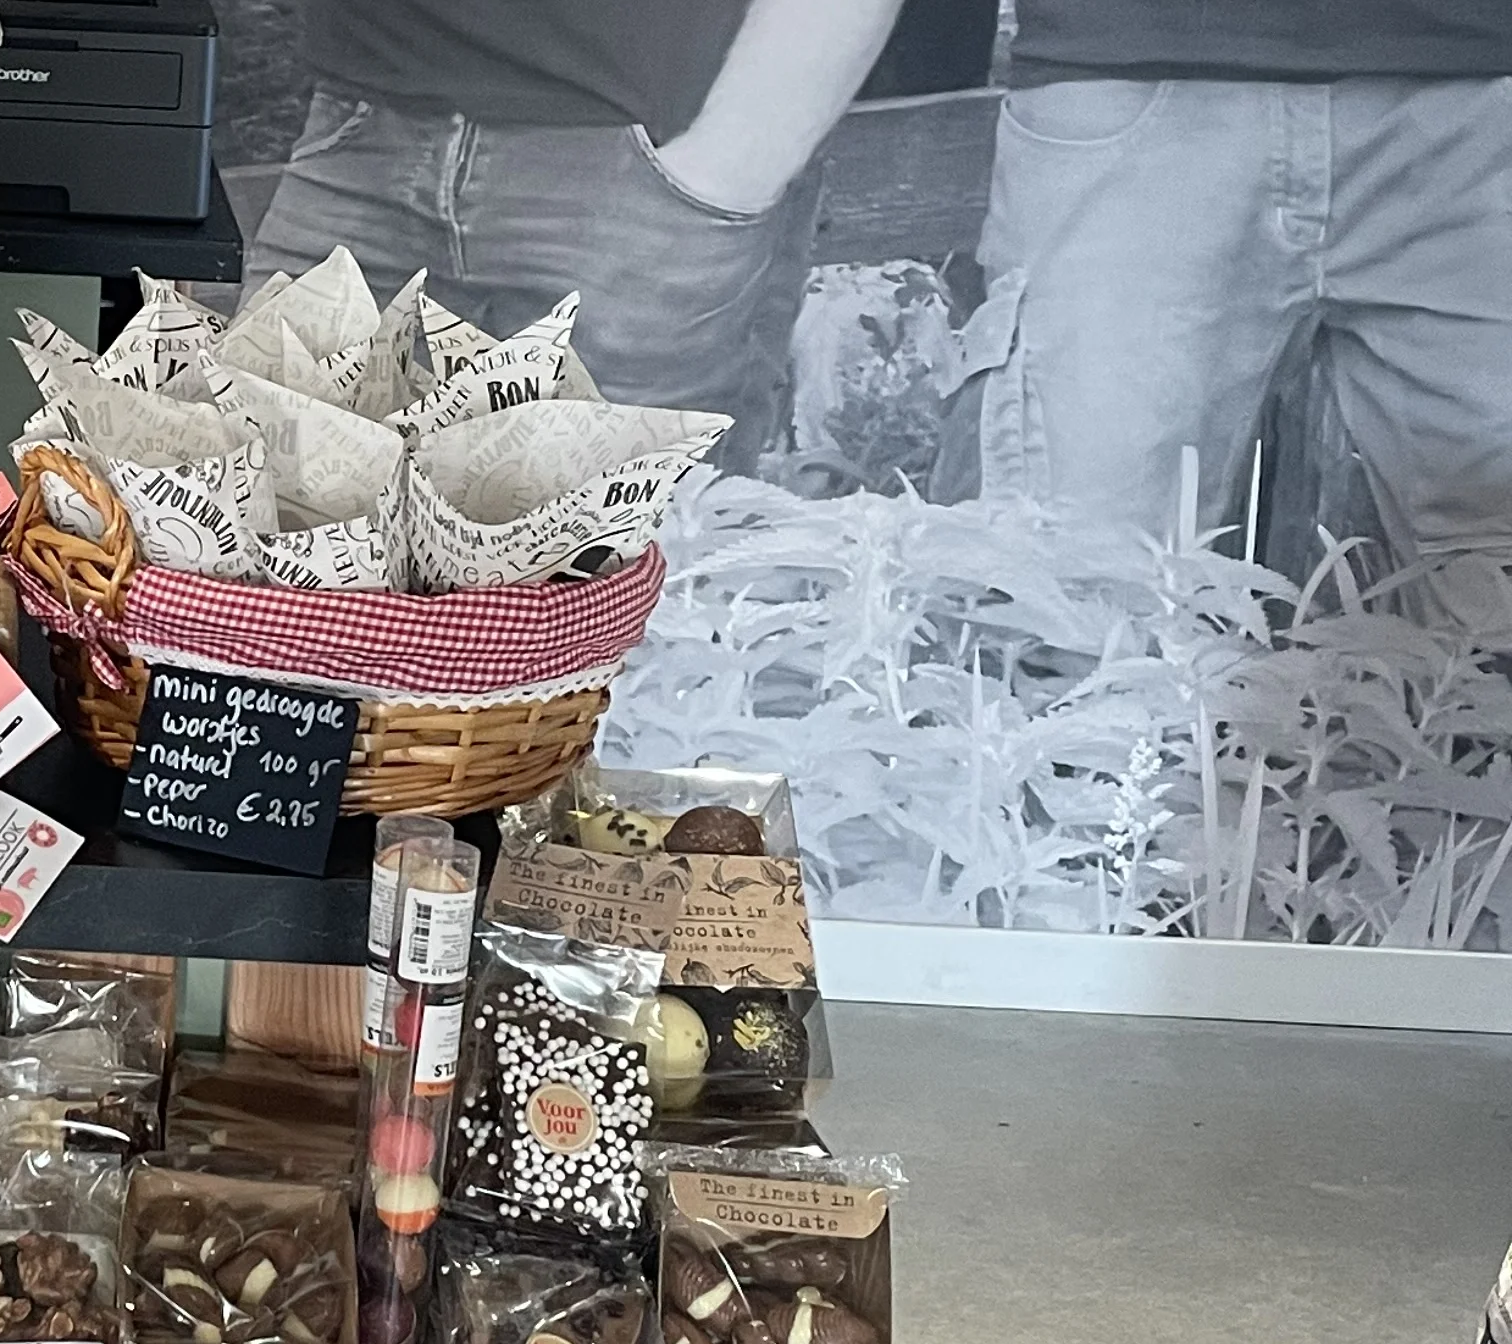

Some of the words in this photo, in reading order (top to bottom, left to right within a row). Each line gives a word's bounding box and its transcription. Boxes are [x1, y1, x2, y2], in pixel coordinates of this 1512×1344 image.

[487, 377, 540, 412] BON
[603, 479, 661, 507] BON
[226, 685, 344, 738] gedroogde
[259, 750, 298, 773] 100
[308, 759, 341, 788] gr
[509, 861, 547, 882] The
[554, 871, 632, 897] finest
[641, 886, 666, 904] in
[518, 888, 643, 926] Chocolate
[685, 903, 740, 918] inest
[746, 907, 769, 918] in
[673, 924, 757, 939] ocolate
[537, 1097, 587, 1121] Voor
[700, 1179, 737, 1194] The
[746, 1183, 820, 1204] finest
[830, 1192, 854, 1207] in
[716, 1205, 838, 1232] Chocolate
